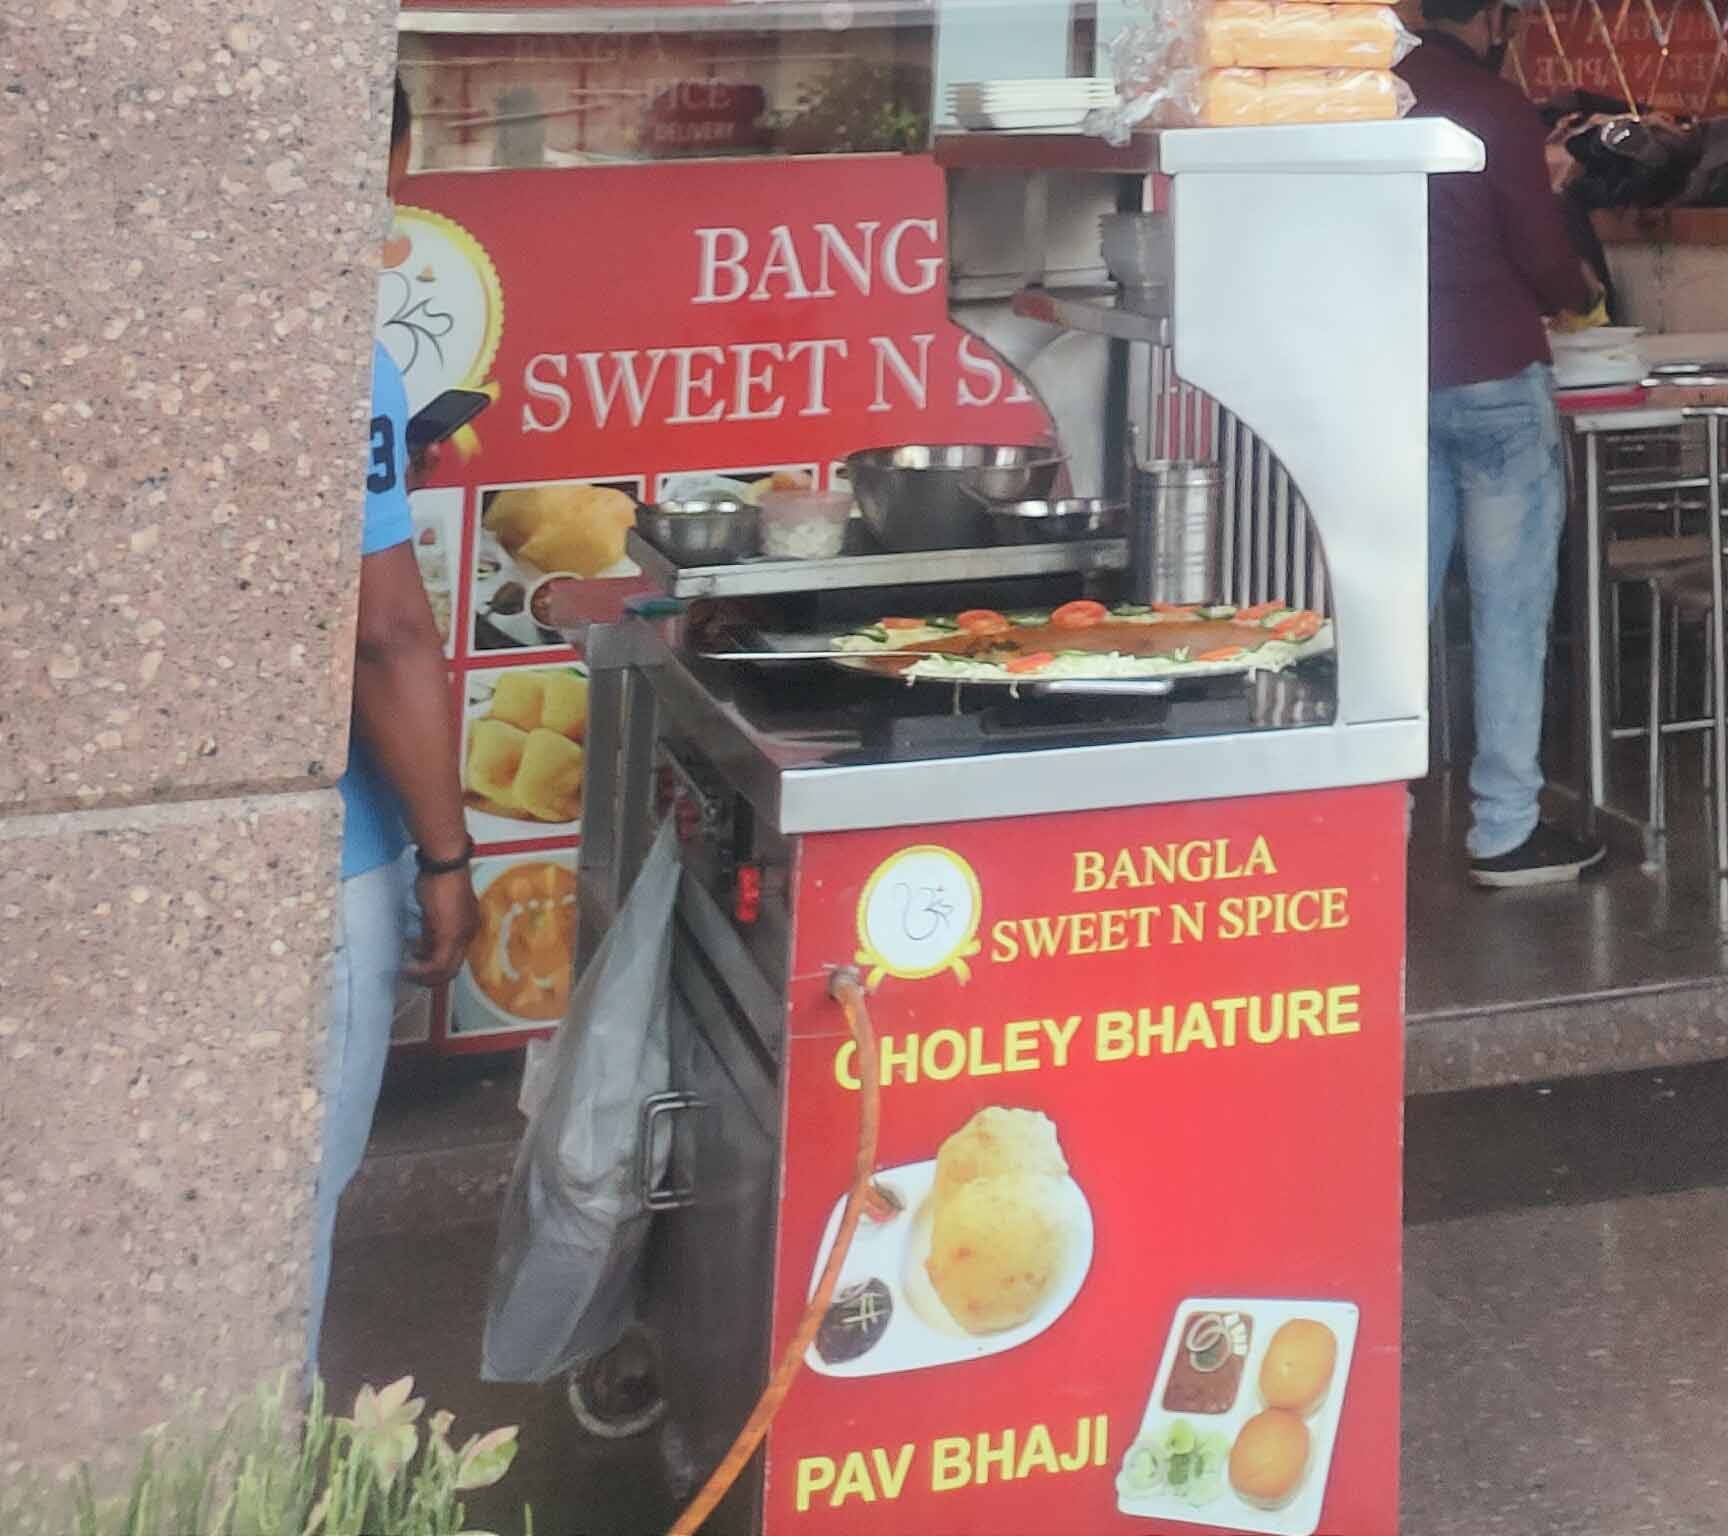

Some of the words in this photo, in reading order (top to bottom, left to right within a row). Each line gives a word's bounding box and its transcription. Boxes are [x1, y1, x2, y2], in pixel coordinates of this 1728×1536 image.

[691, 217, 943, 305] BANG
[521, 338, 848, 433] SWEET
[870, 334, 935, 412] N
[956, 333, 1036, 408] S
[1072, 835, 1278, 893] BANGLA
[991, 906, 1160, 963] SWEET
[1169, 901, 1206, 944] N
[1218, 887, 1350, 941] SPICE
[834, 1015, 1081, 1090] CHOLEY
[1095, 984, 1362, 1063] BHATURE
[795, 1443, 915, 1512] PAV
[931, 1414, 1109, 1492] BHAJI
